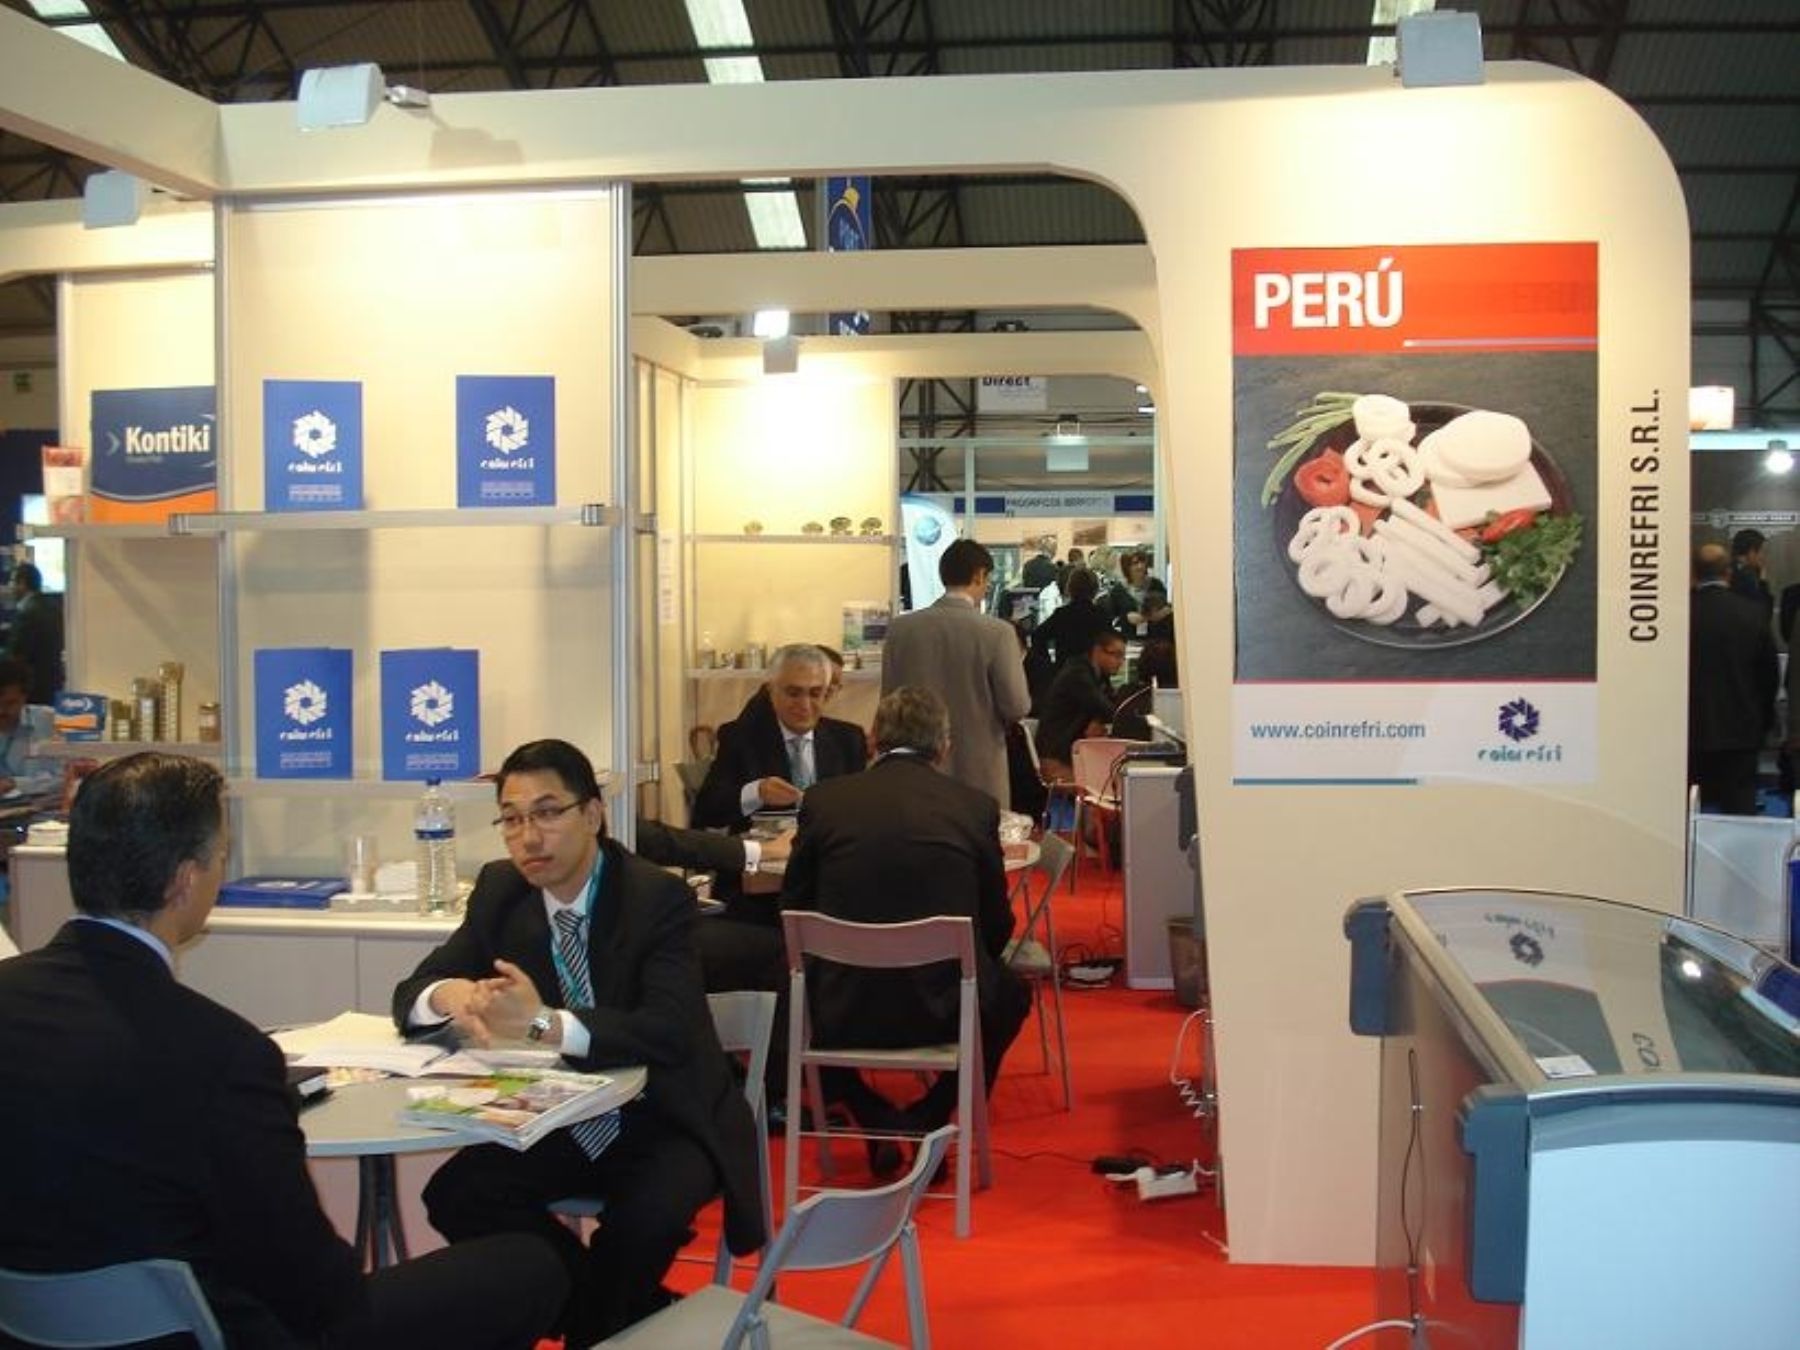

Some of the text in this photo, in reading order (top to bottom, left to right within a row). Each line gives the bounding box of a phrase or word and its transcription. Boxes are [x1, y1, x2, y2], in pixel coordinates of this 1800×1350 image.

[1254, 256, 1403, 330] PERÚ
[125, 424, 210, 455] Kontiki
[1629, 389, 1661, 642] COINREFRI S.R.L.
[1250, 720, 1426, 738] www.coinrefri.com
